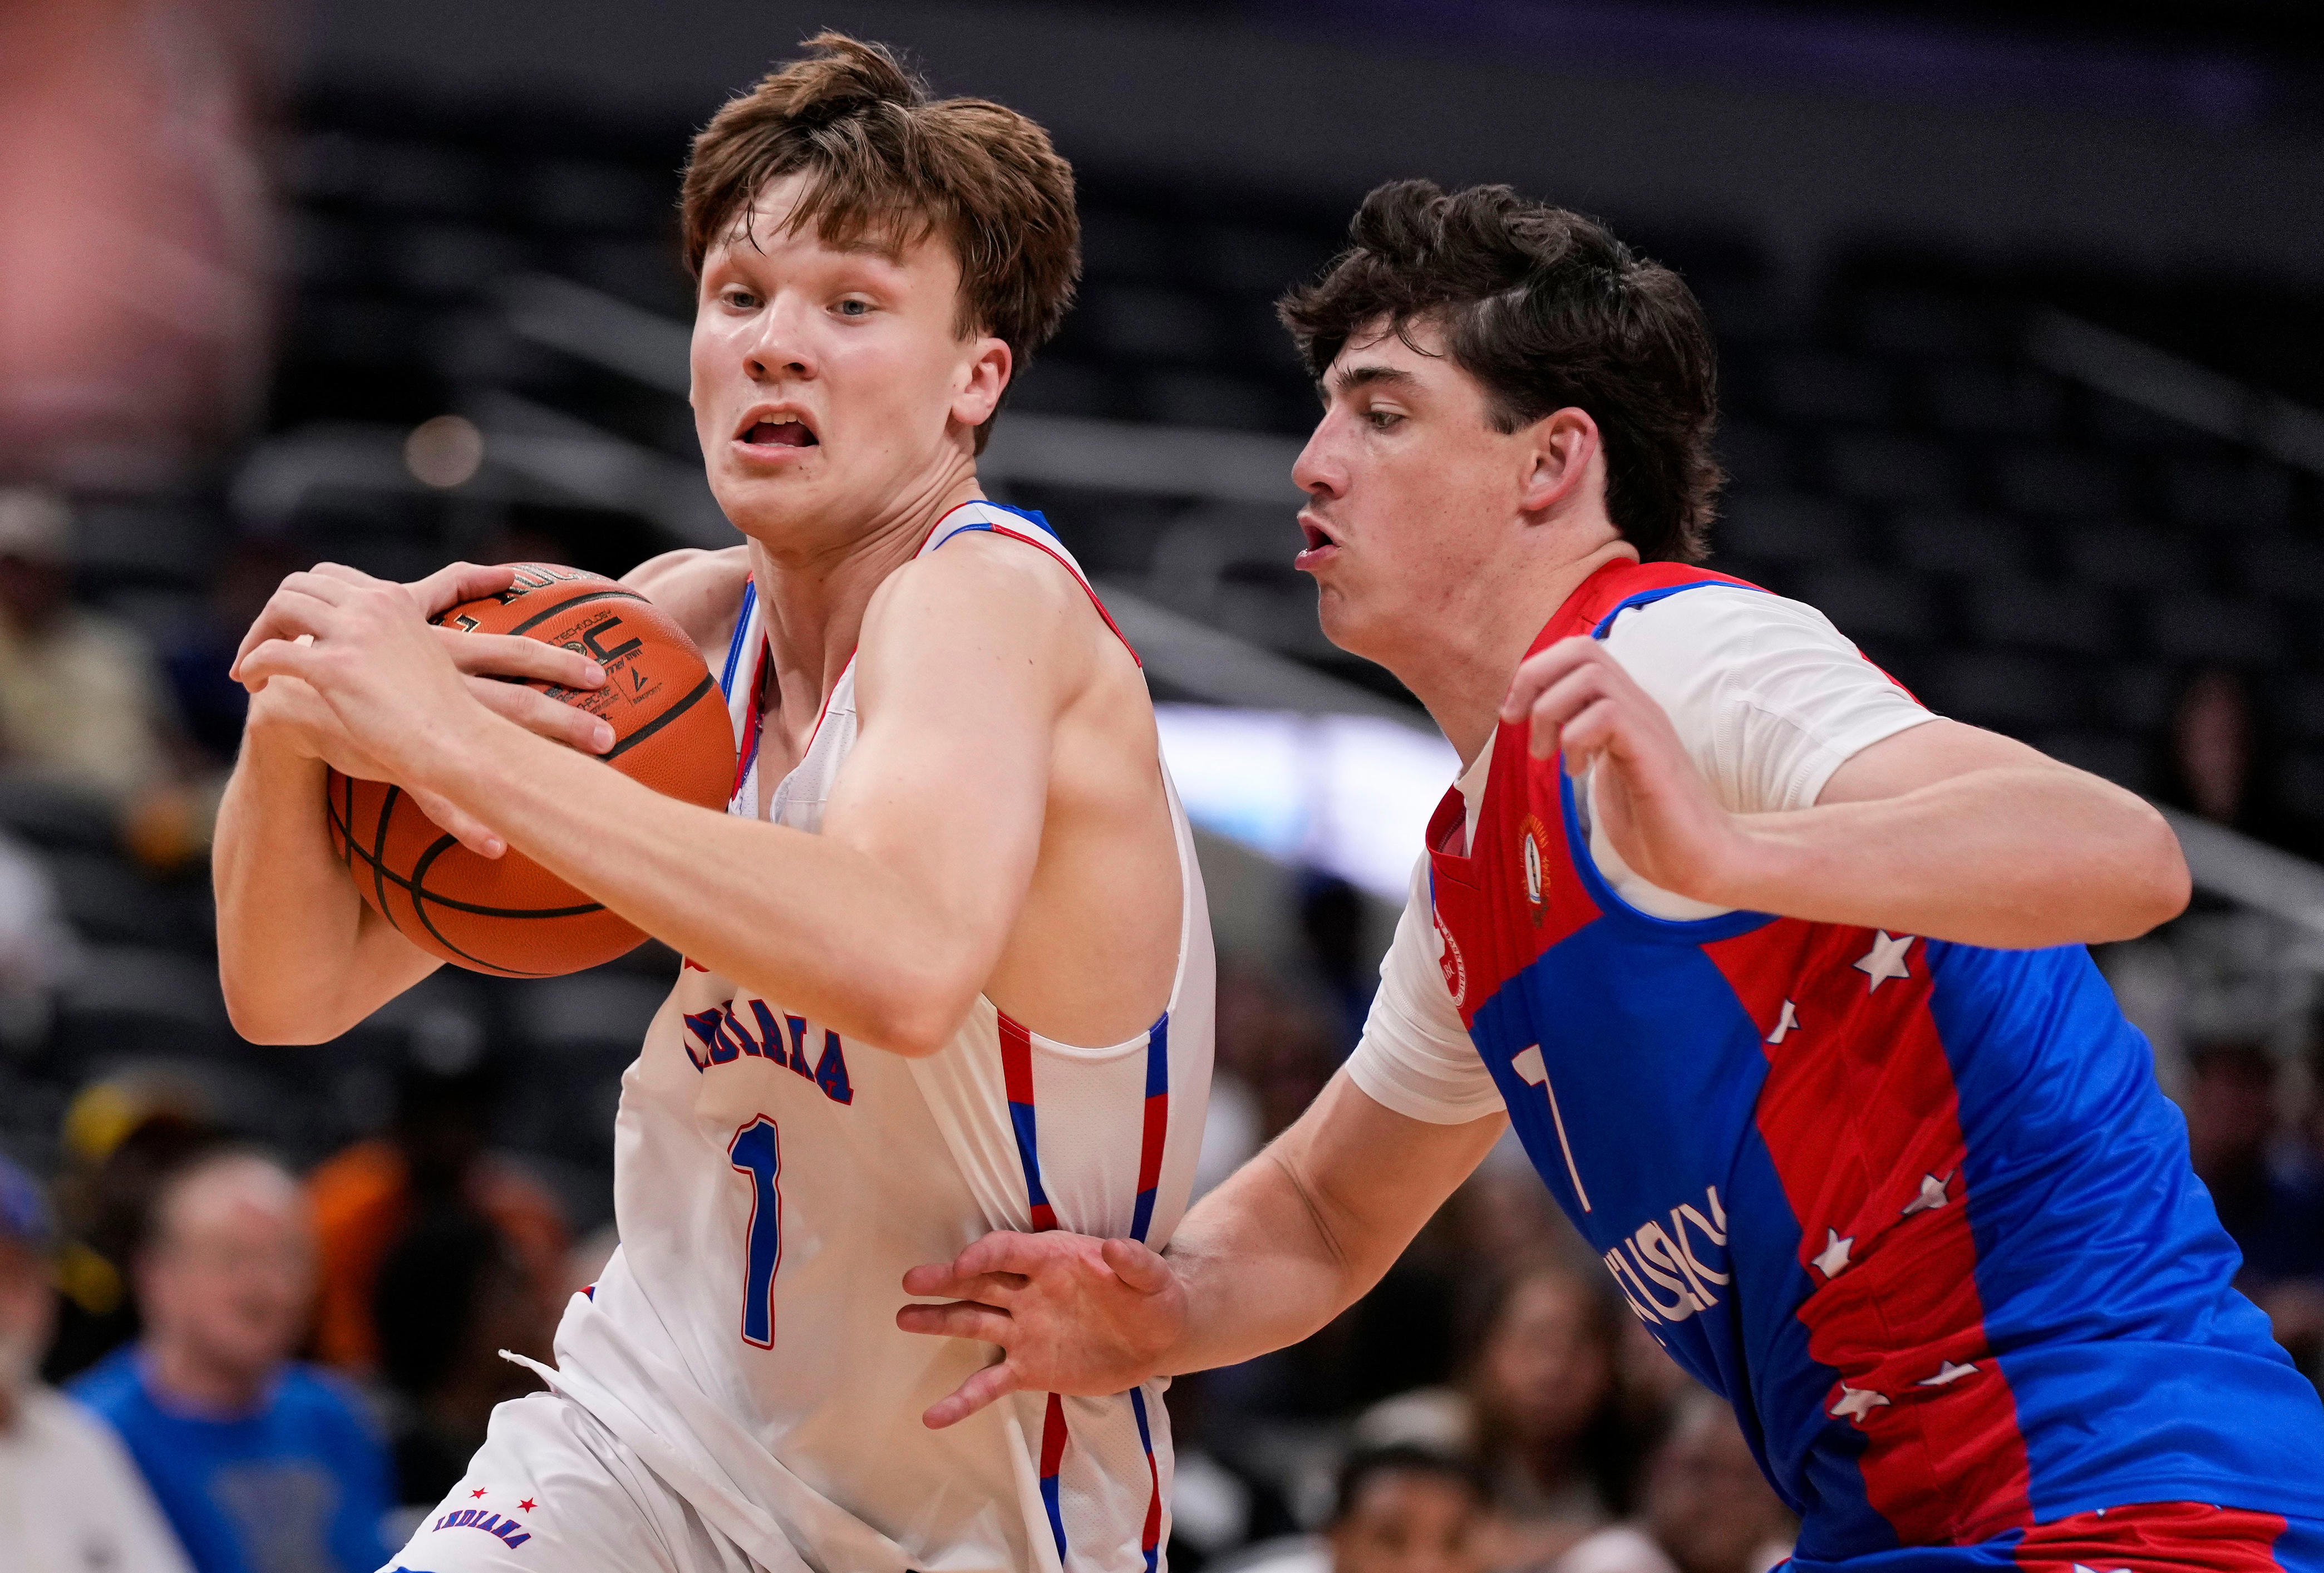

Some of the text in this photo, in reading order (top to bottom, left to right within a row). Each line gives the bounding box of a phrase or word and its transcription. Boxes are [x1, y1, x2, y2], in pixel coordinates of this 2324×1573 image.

[682, 999, 854, 1106] NDIANA
[1511, 1043, 1592, 1213] 7
[727, 1113, 782, 1351] 1
[432, 1510, 531, 1550] INDIANA
